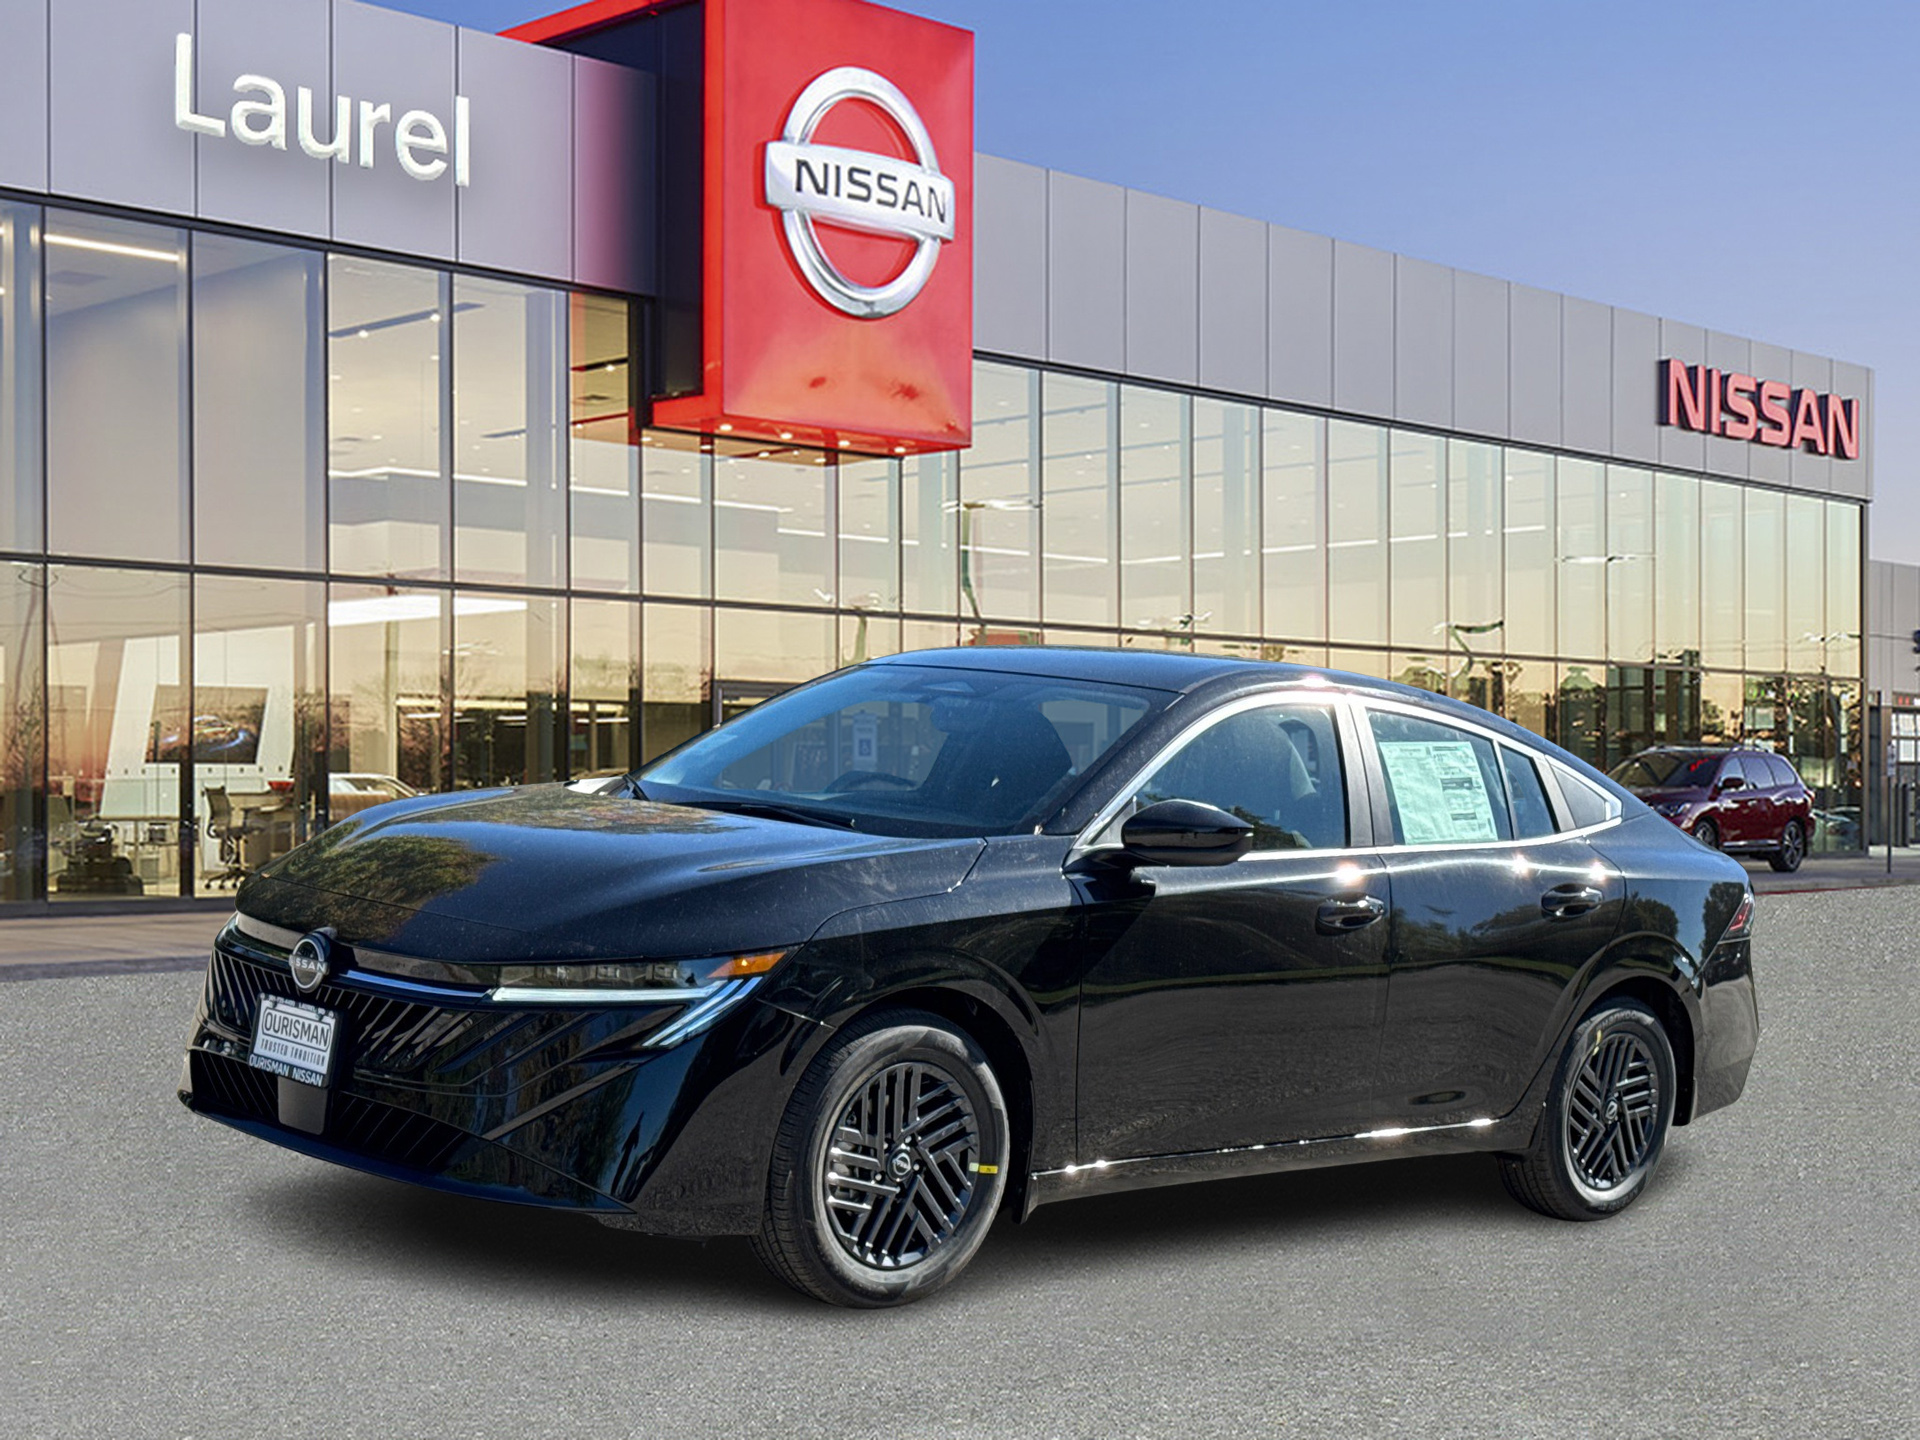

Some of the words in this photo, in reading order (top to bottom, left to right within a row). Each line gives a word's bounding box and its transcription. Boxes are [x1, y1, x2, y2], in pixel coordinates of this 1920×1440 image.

[175, 32, 470, 188] Laurel
[794, 158, 947, 224] NISSAN
[1657, 358, 1860, 460] NISSAN
[290, 955, 327, 974] SSAN
[264, 1011, 330, 1047] OURISMAN
[260, 1038, 288, 1057] TRUSTED
[249, 1053, 290, 1077] OURISMAN
[291, 1066, 324, 1088] NISSAN
